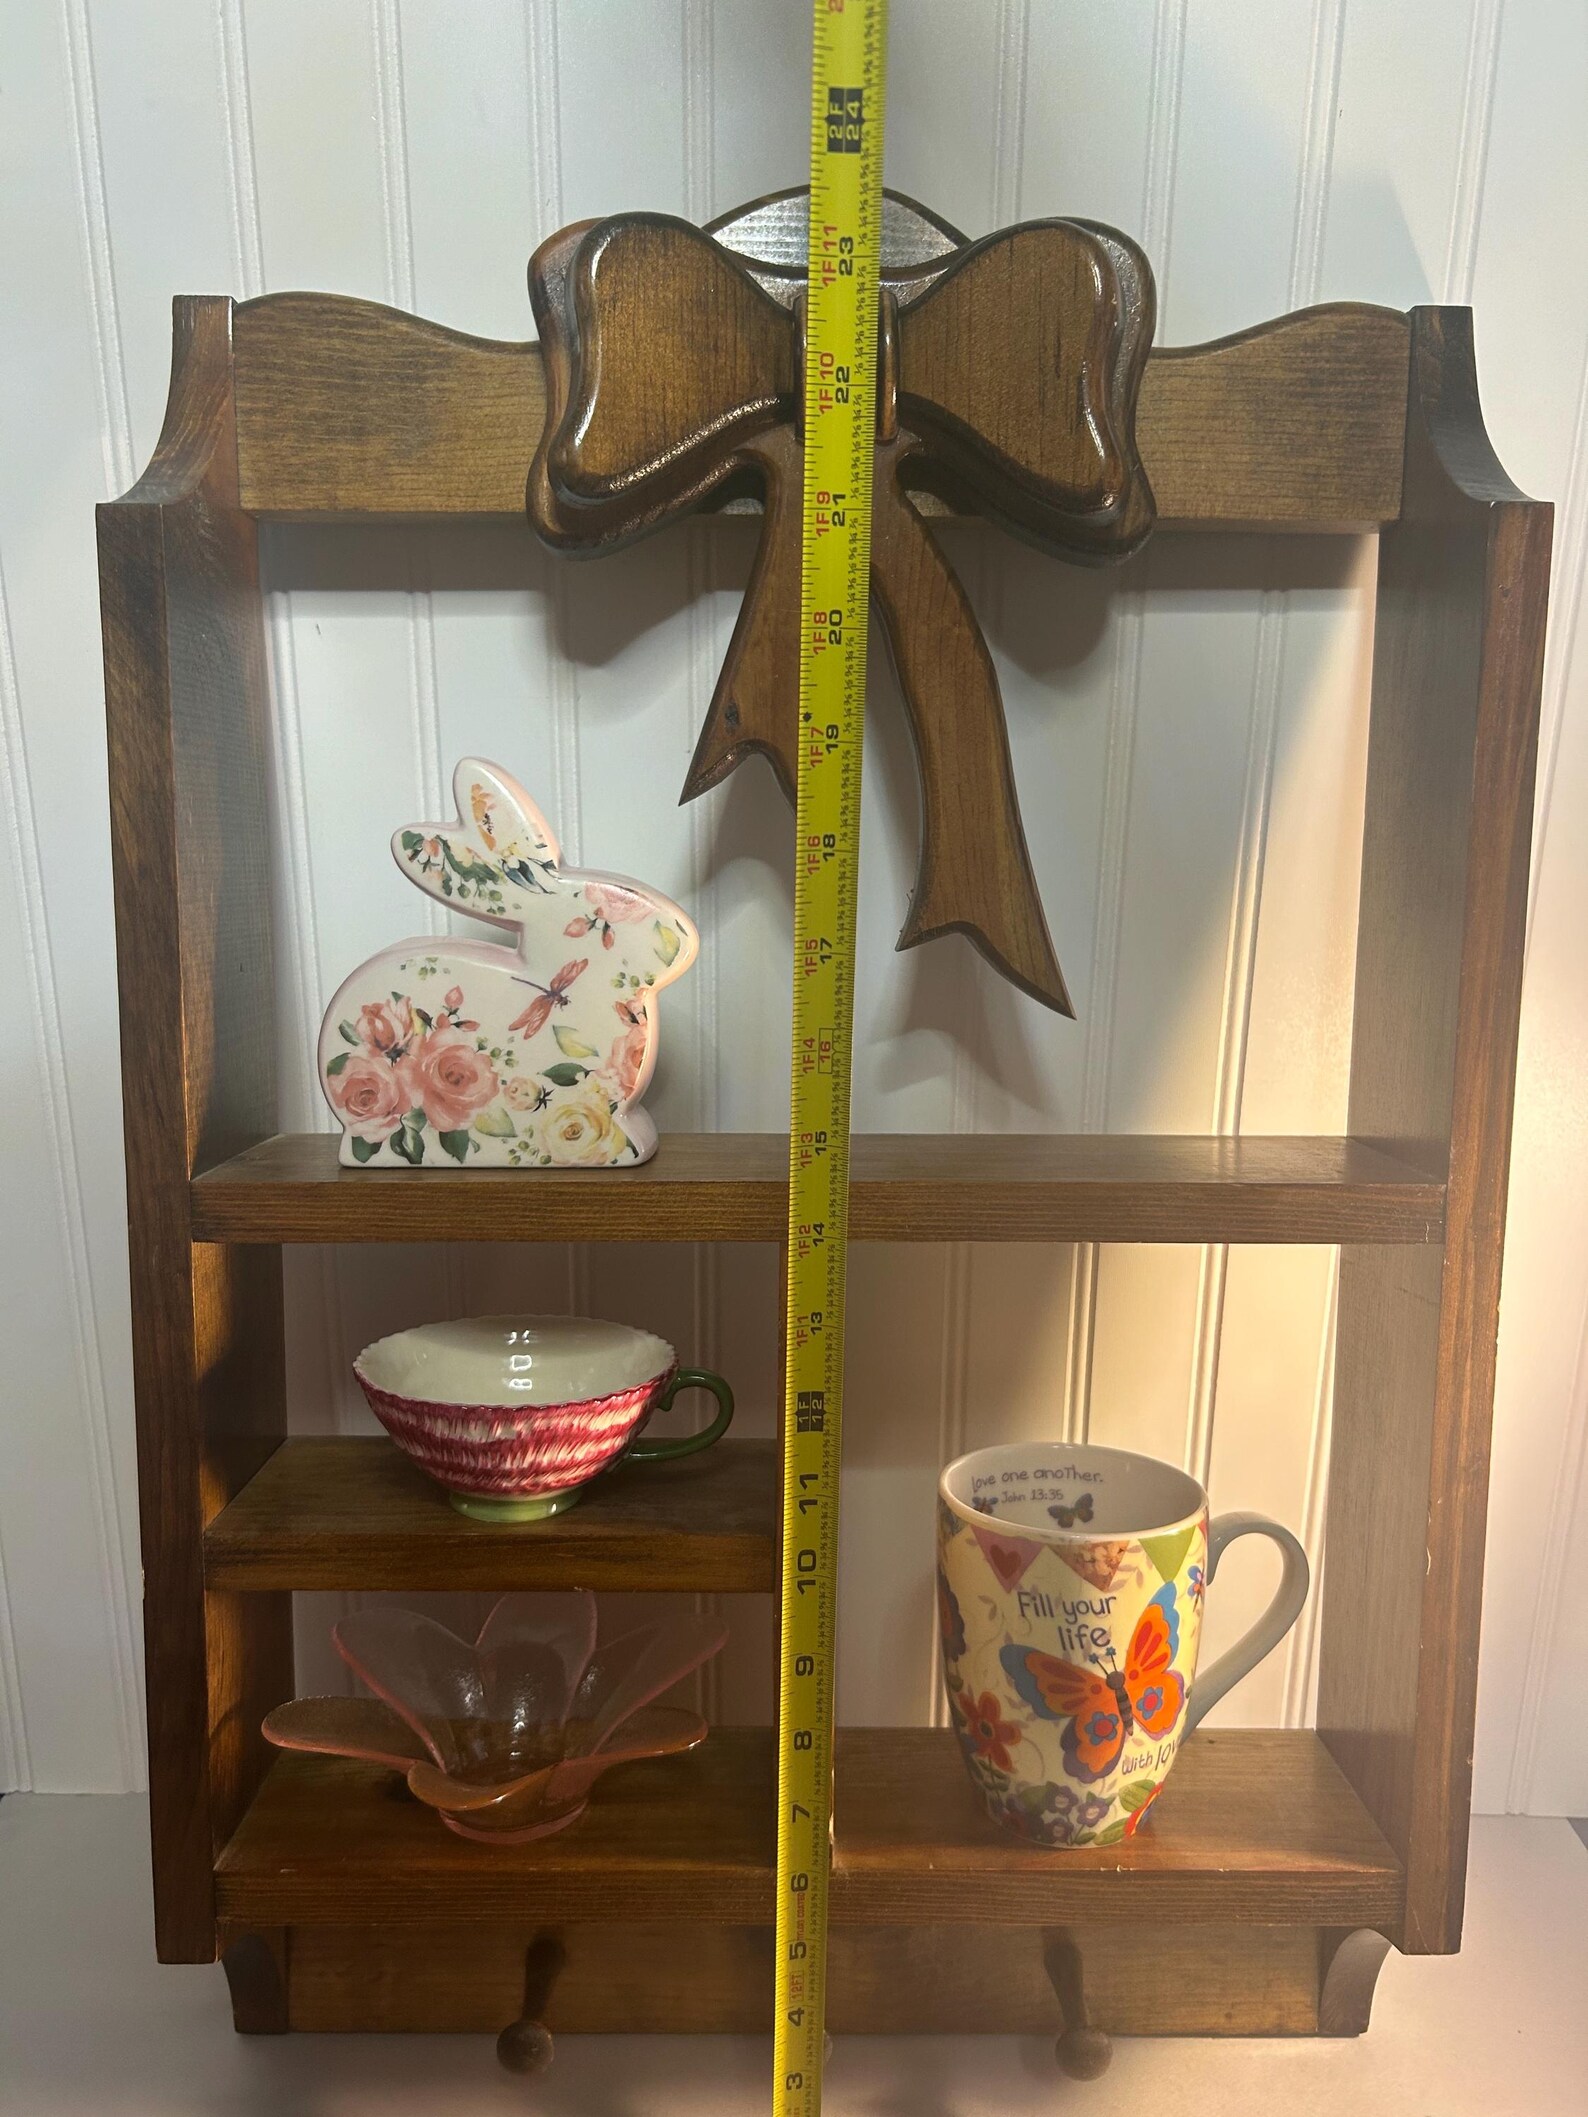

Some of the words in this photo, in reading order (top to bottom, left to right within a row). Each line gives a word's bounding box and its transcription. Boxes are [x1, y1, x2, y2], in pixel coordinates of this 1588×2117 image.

[830, 102, 844, 139] 2F
[846, 100, 860, 140] 24
[839, 236, 854, 276] 23
[836, 366, 850, 404] 22
[832, 493, 846, 527] 21
[828, 609, 842, 645] 20
[825, 724, 838, 754] 19
[823, 834, 836, 862] 18
[820, 937, 832, 964] 17
[820, 1041, 831, 1064] 16
[815, 1130, 826, 1156] 15
[813, 1222, 825, 1247] 14
[811, 1311, 822, 1336] 13
[812, 1399, 822, 1423] 12
[1002, 1470, 1028, 1482] one
[799, 1473, 818, 1515] 11
[1002, 1491, 1026, 1503] John
[1031, 1489, 1064, 1500] 13:35
[797, 1549, 816, 1595] 10
[1017, 1592, 1054, 1618] Fill
[1062, 1596, 1116, 1625] your
[1058, 1624, 1111, 1651] life
[796, 1655, 814, 1676] 9
[794, 1730, 812, 1750] 8
[792, 1804, 810, 1824] 7
[791, 1873, 809, 1892] 6
[789, 1941, 806, 1960] 5
[788, 2007, 804, 2026] 4
[786, 2072, 803, 2090] 3
